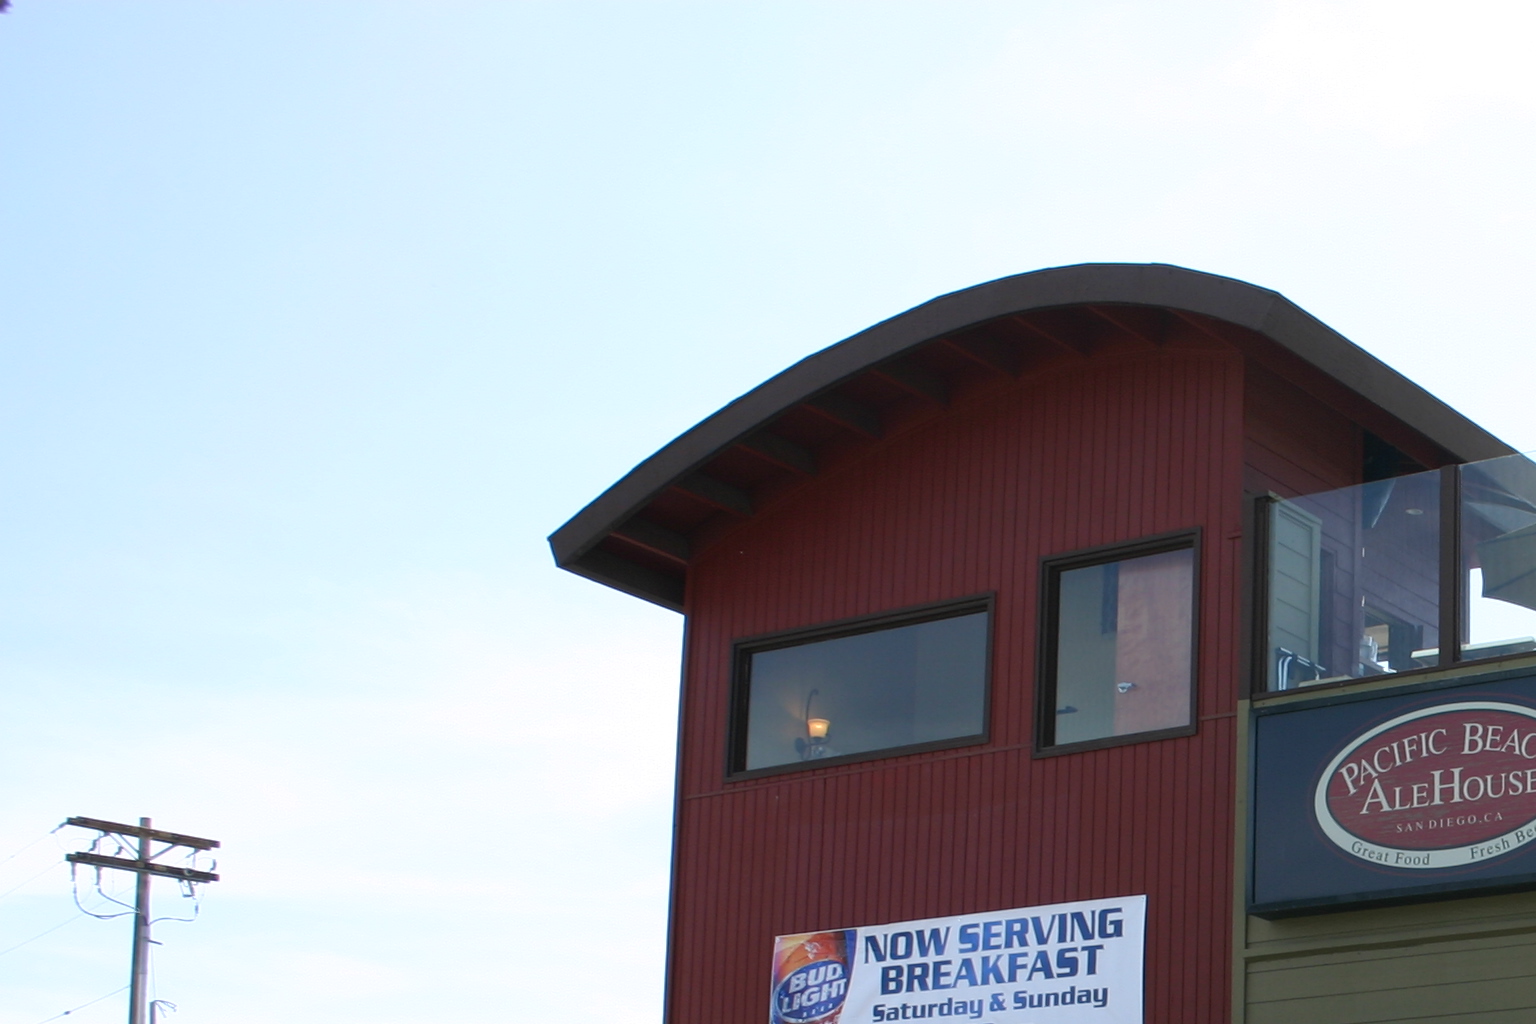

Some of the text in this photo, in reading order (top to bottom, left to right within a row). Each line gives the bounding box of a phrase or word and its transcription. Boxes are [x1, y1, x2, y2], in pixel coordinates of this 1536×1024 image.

[1339, 728, 1449, 796] PACIFIC
[1396, 822, 1424, 833] SAN
[1351, 840, 1389, 862] Great
[1395, 852, 1431, 866] Food
[1470, 838, 1511, 860] Fresh
[864, 907, 1124, 964] NOW SERVING
[788, 963, 843, 994] BUD
[880, 944, 1105, 996] BREAKFAST
[781, 978, 847, 1014] LIGHT
[872, 985, 1109, 1023] Saturday & Sunday
